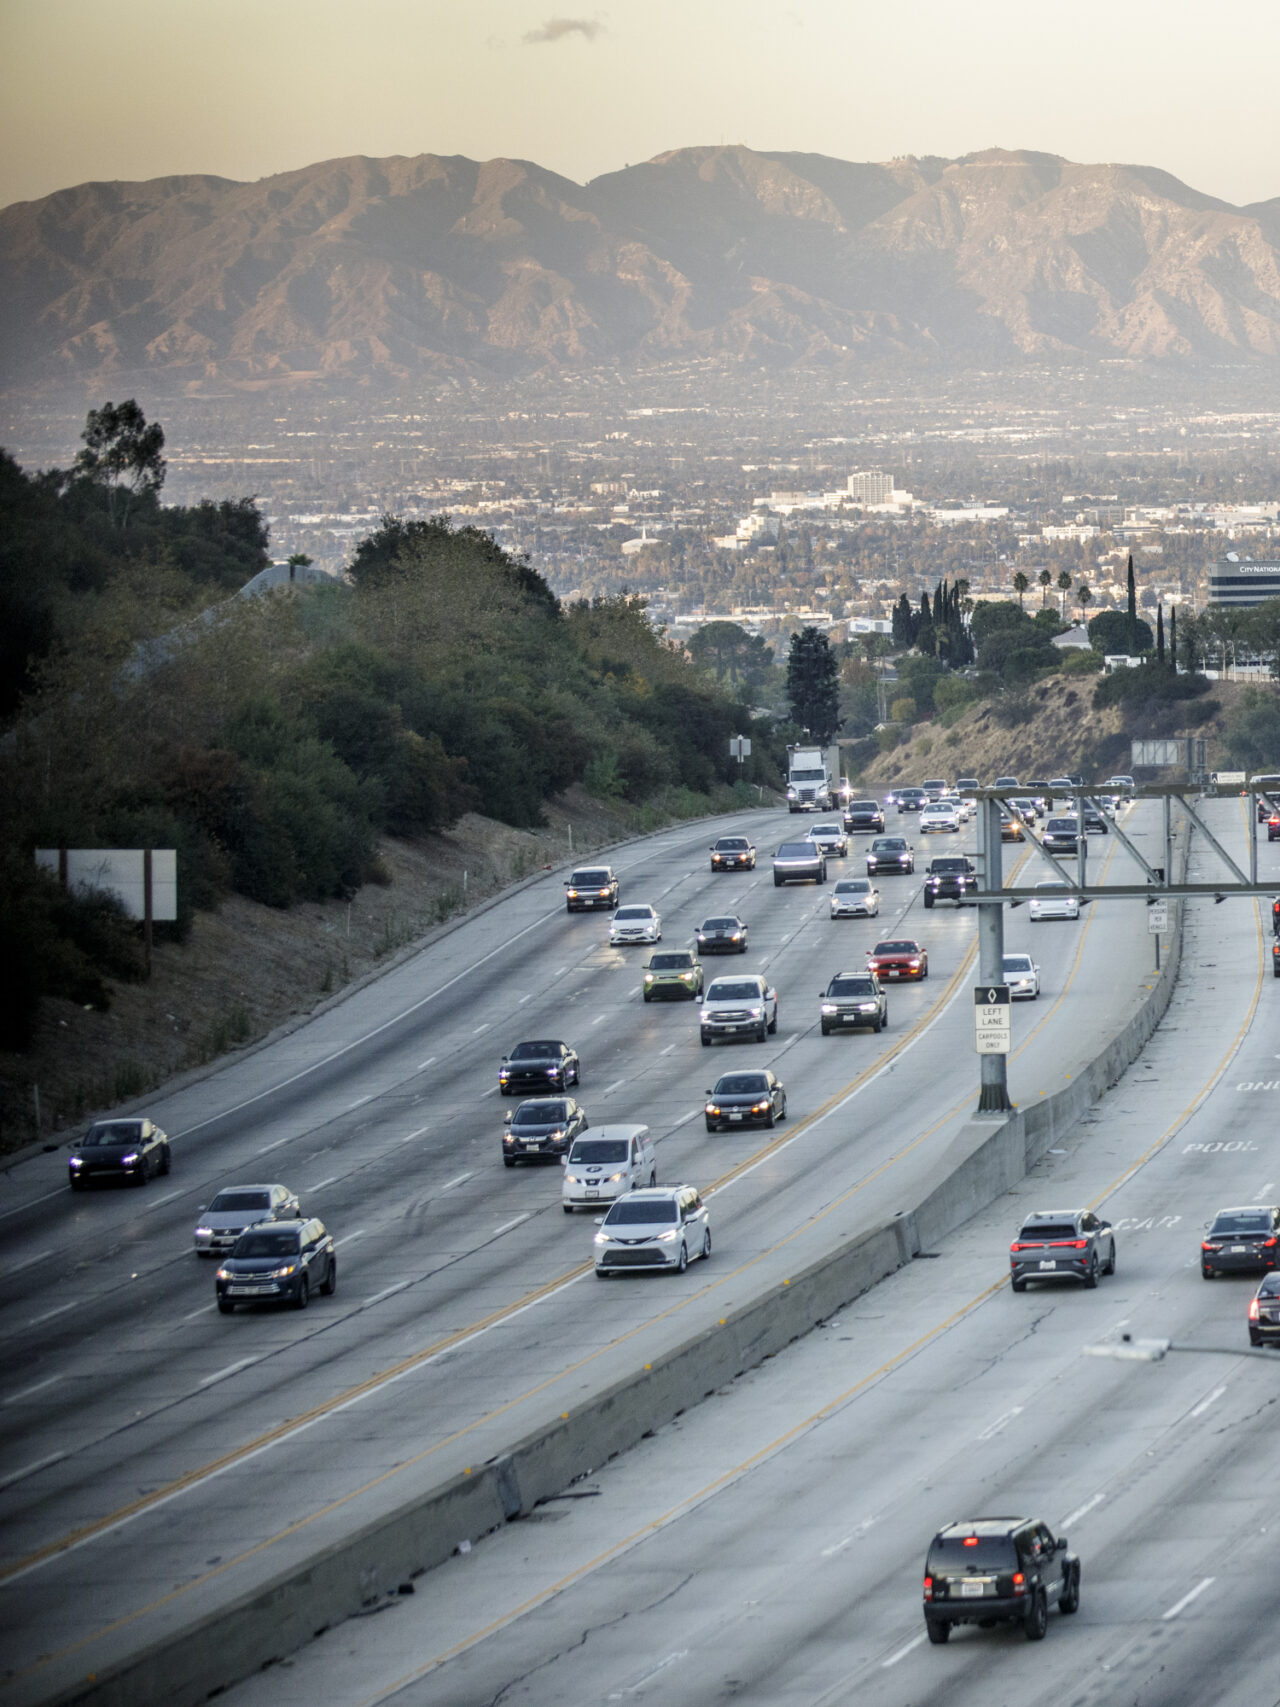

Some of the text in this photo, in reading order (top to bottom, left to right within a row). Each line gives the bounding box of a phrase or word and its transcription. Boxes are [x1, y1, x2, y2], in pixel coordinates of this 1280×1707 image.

[983, 1008, 1002, 1016] LEFT
[982, 1018, 1003, 1026] LANE
[1182, 1140, 1259, 1154] POOL
[1114, 1215, 1183, 1231] CAR
